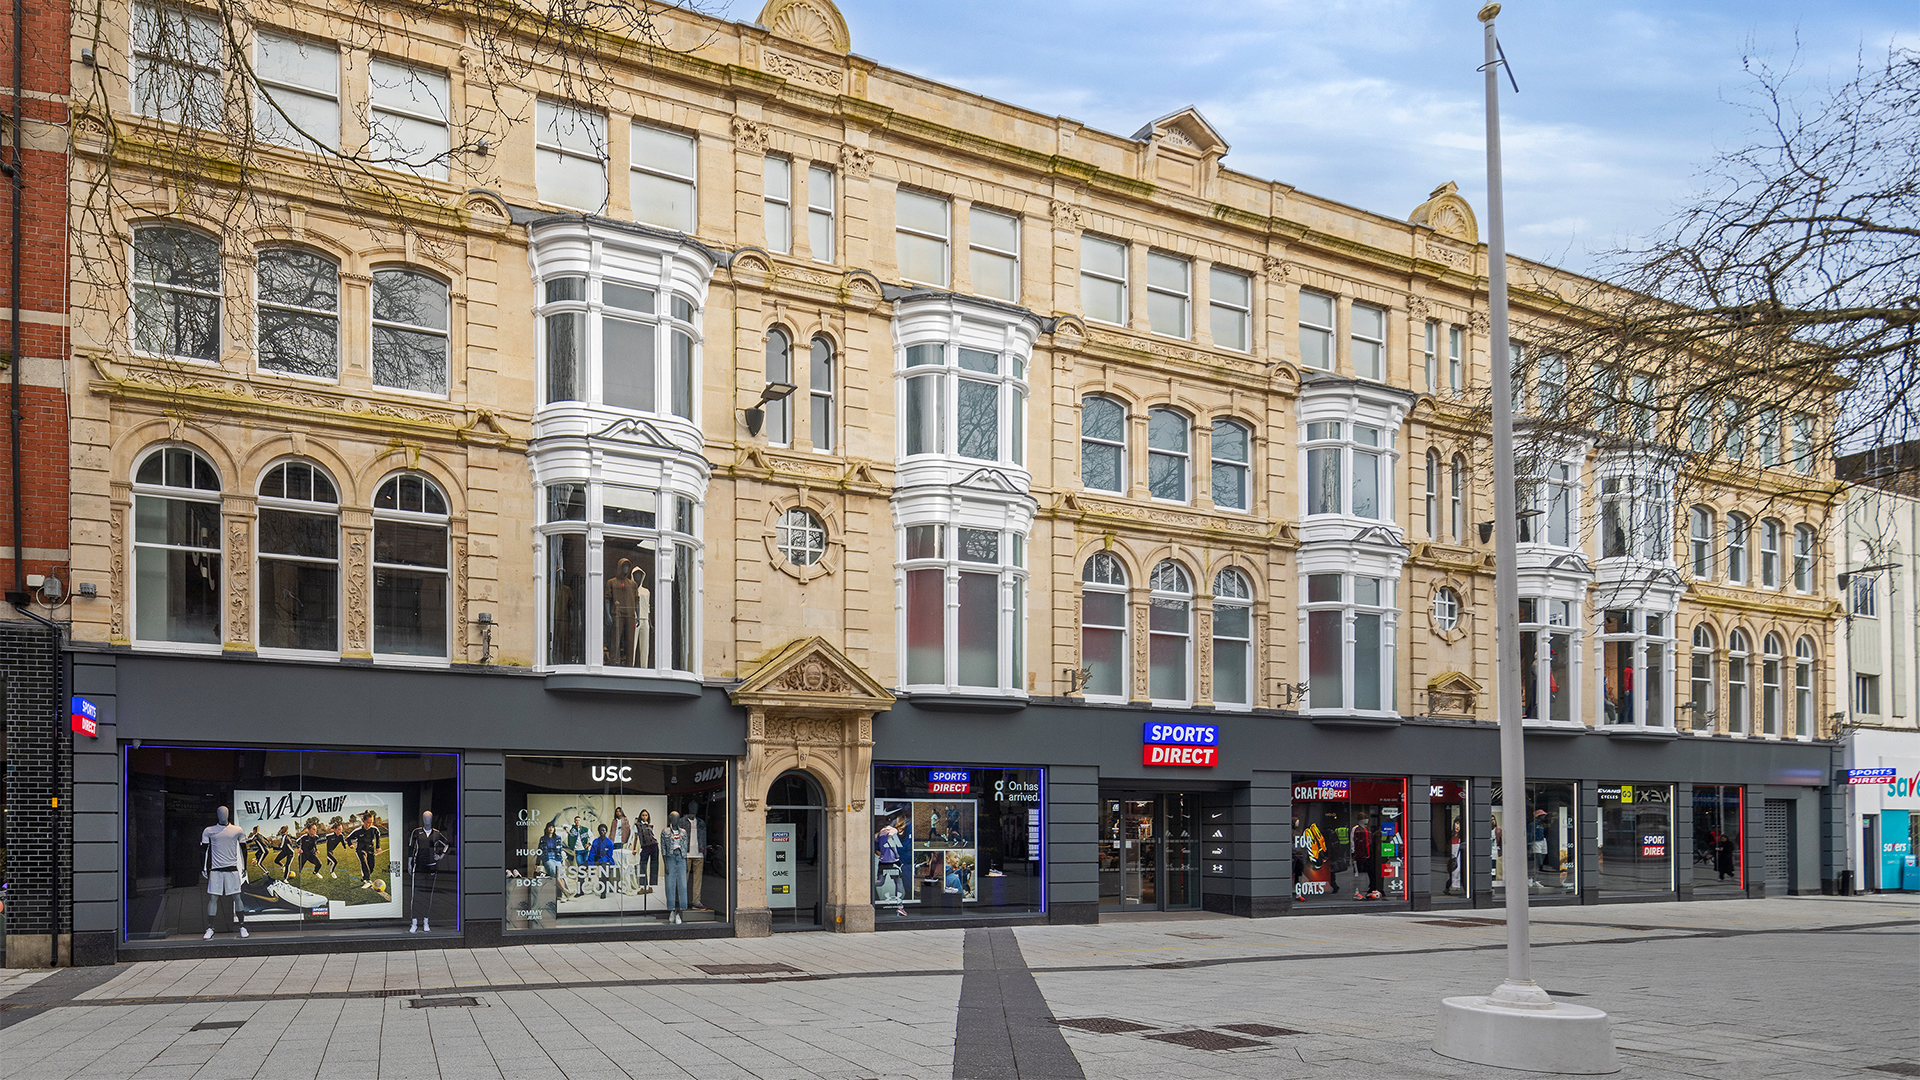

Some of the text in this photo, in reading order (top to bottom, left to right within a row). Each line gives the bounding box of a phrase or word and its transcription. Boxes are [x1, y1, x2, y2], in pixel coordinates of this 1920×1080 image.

[82, 700, 96, 718] SPORTS
[82, 717, 96, 734] DIRECT
[1151, 725, 1214, 743] SPORTS
[800, 753, 808, 761] 67
[1151, 747, 1214, 764] DIRECT
[591, 765, 632, 782] USC
[933, 772, 967, 781] SPORTS
[933, 783, 968, 792] DIRECT
[1008, 781, 1039, 791] On has
[1322, 780, 1347, 788] SPORTS
[1294, 786, 1335, 800] CRAFTED
[1429, 785, 1444, 797] ME
[1622, 790, 1632, 798] GO
[1008, 793, 1040, 802] arrived.
[244, 792, 347, 820] GET MAD READY
[518, 808, 540, 821] C.P.
[1294, 835, 1313, 848] FOR
[1883, 840, 1907, 852] savers
[516, 848, 543, 857] HUGO
[516, 879, 543, 887] BOSS
[577, 881, 627, 894] ICONS
[1295, 882, 1325, 895] GOALS
